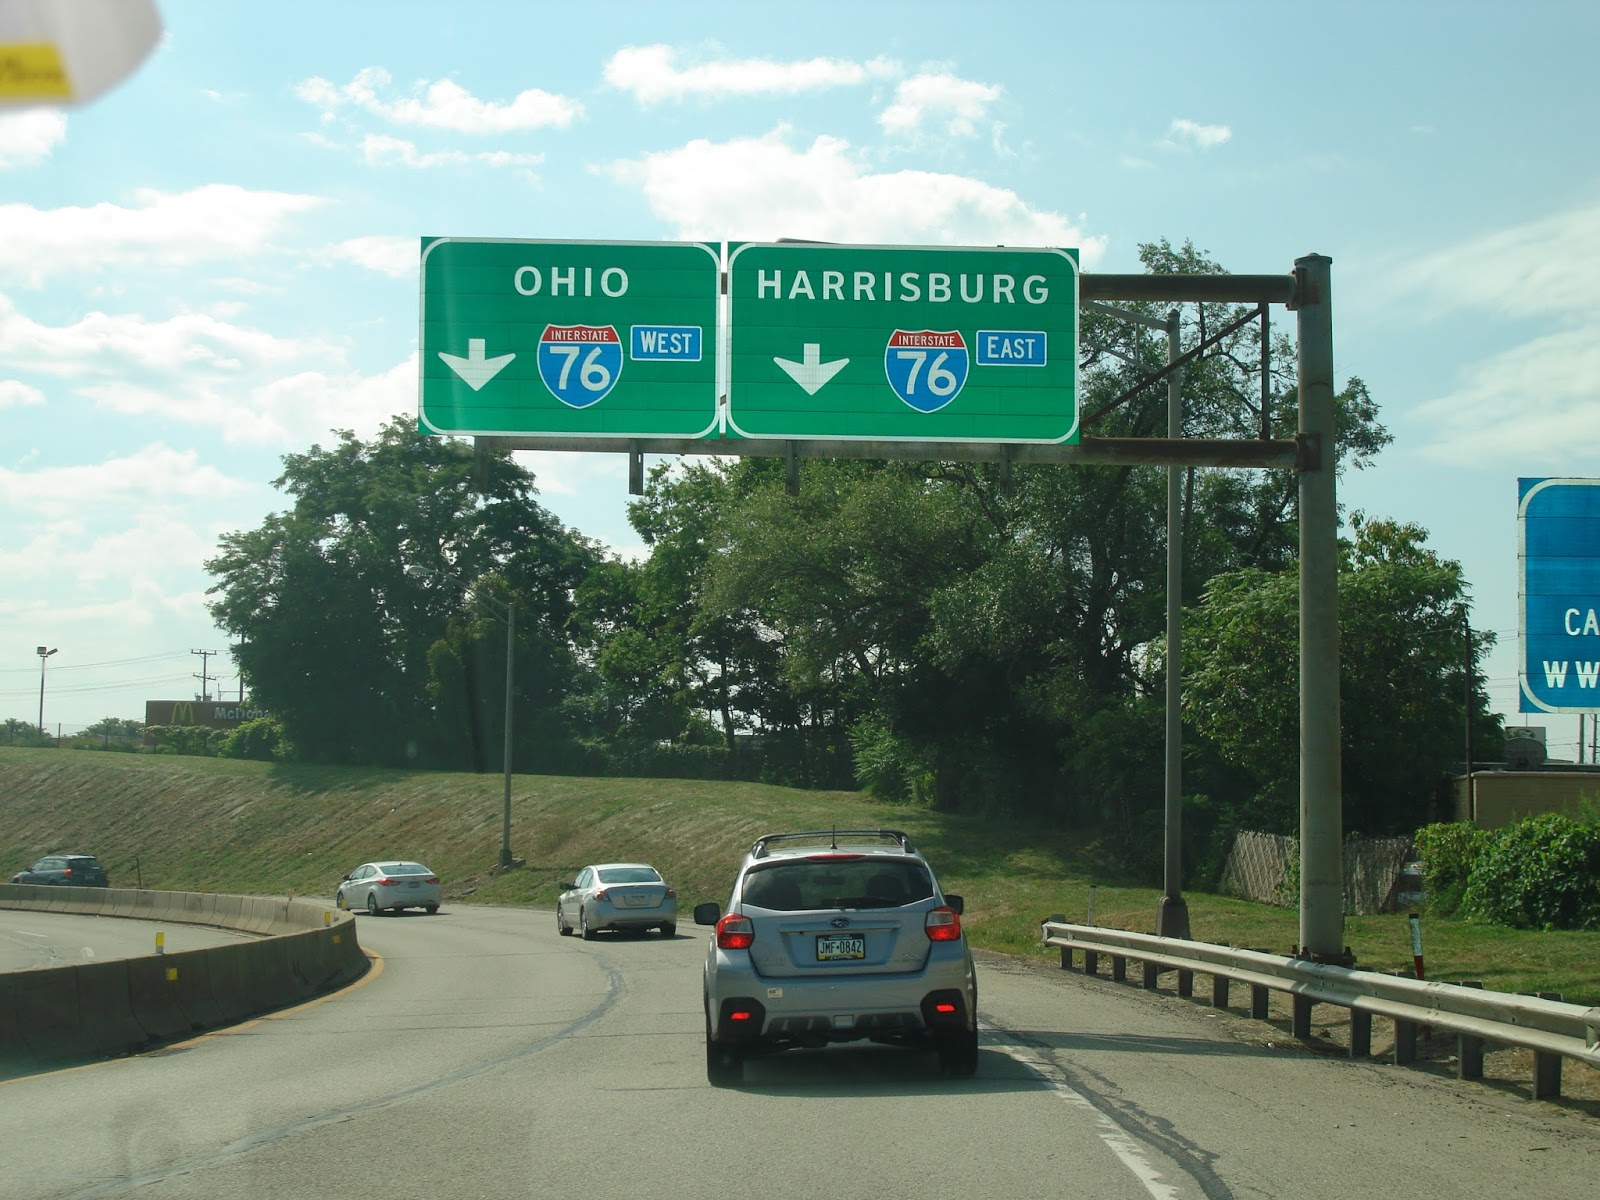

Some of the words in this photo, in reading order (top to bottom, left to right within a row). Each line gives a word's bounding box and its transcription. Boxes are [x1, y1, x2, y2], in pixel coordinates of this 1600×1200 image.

[514, 266, 629, 297] OHIO
[757, 269, 1049, 304] HARRISBURG
[551, 330, 609, 341] INTERSTATE
[640, 331, 692, 354] WEST
[898, 335, 955, 346] INTERSTATE
[987, 336, 1035, 359] EAST
[549, 346, 611, 391] 76
[897, 351, 957, 396] 76
